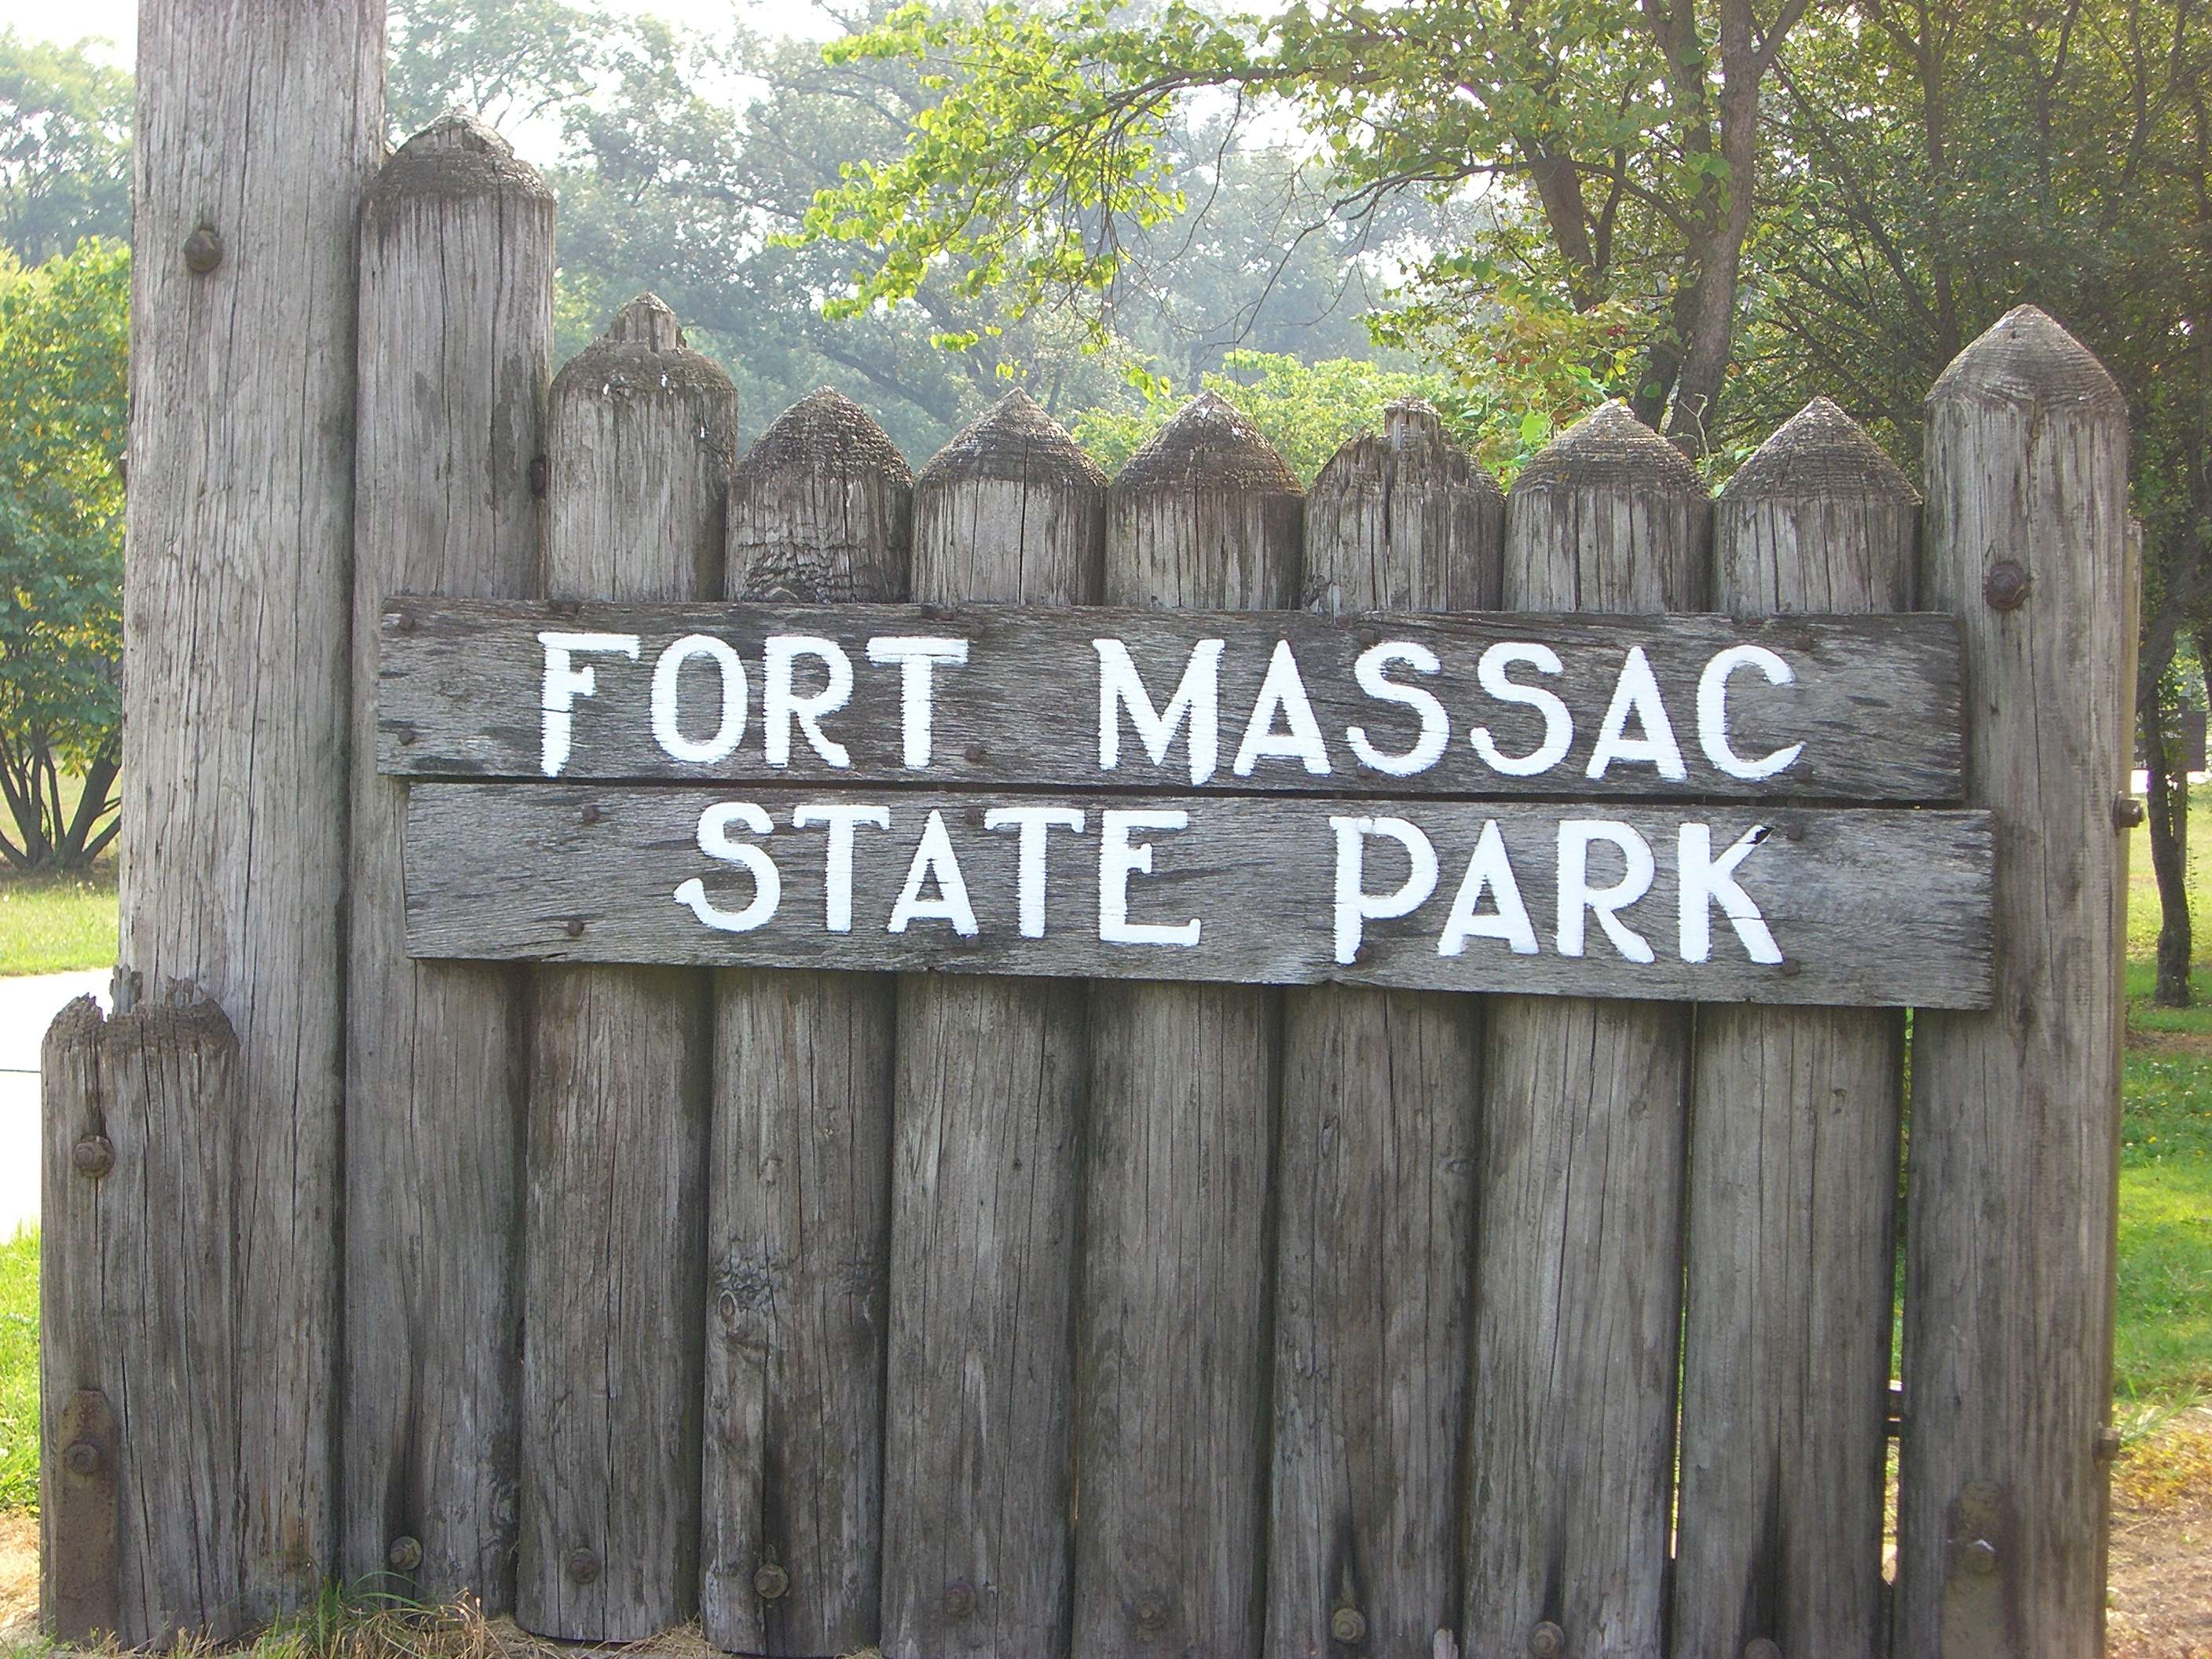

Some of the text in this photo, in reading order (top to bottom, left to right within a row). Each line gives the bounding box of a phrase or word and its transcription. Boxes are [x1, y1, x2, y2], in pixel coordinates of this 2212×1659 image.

[537, 631, 1806, 786] FORT MASSAC
[672, 801, 1784, 965] STATE PARK
